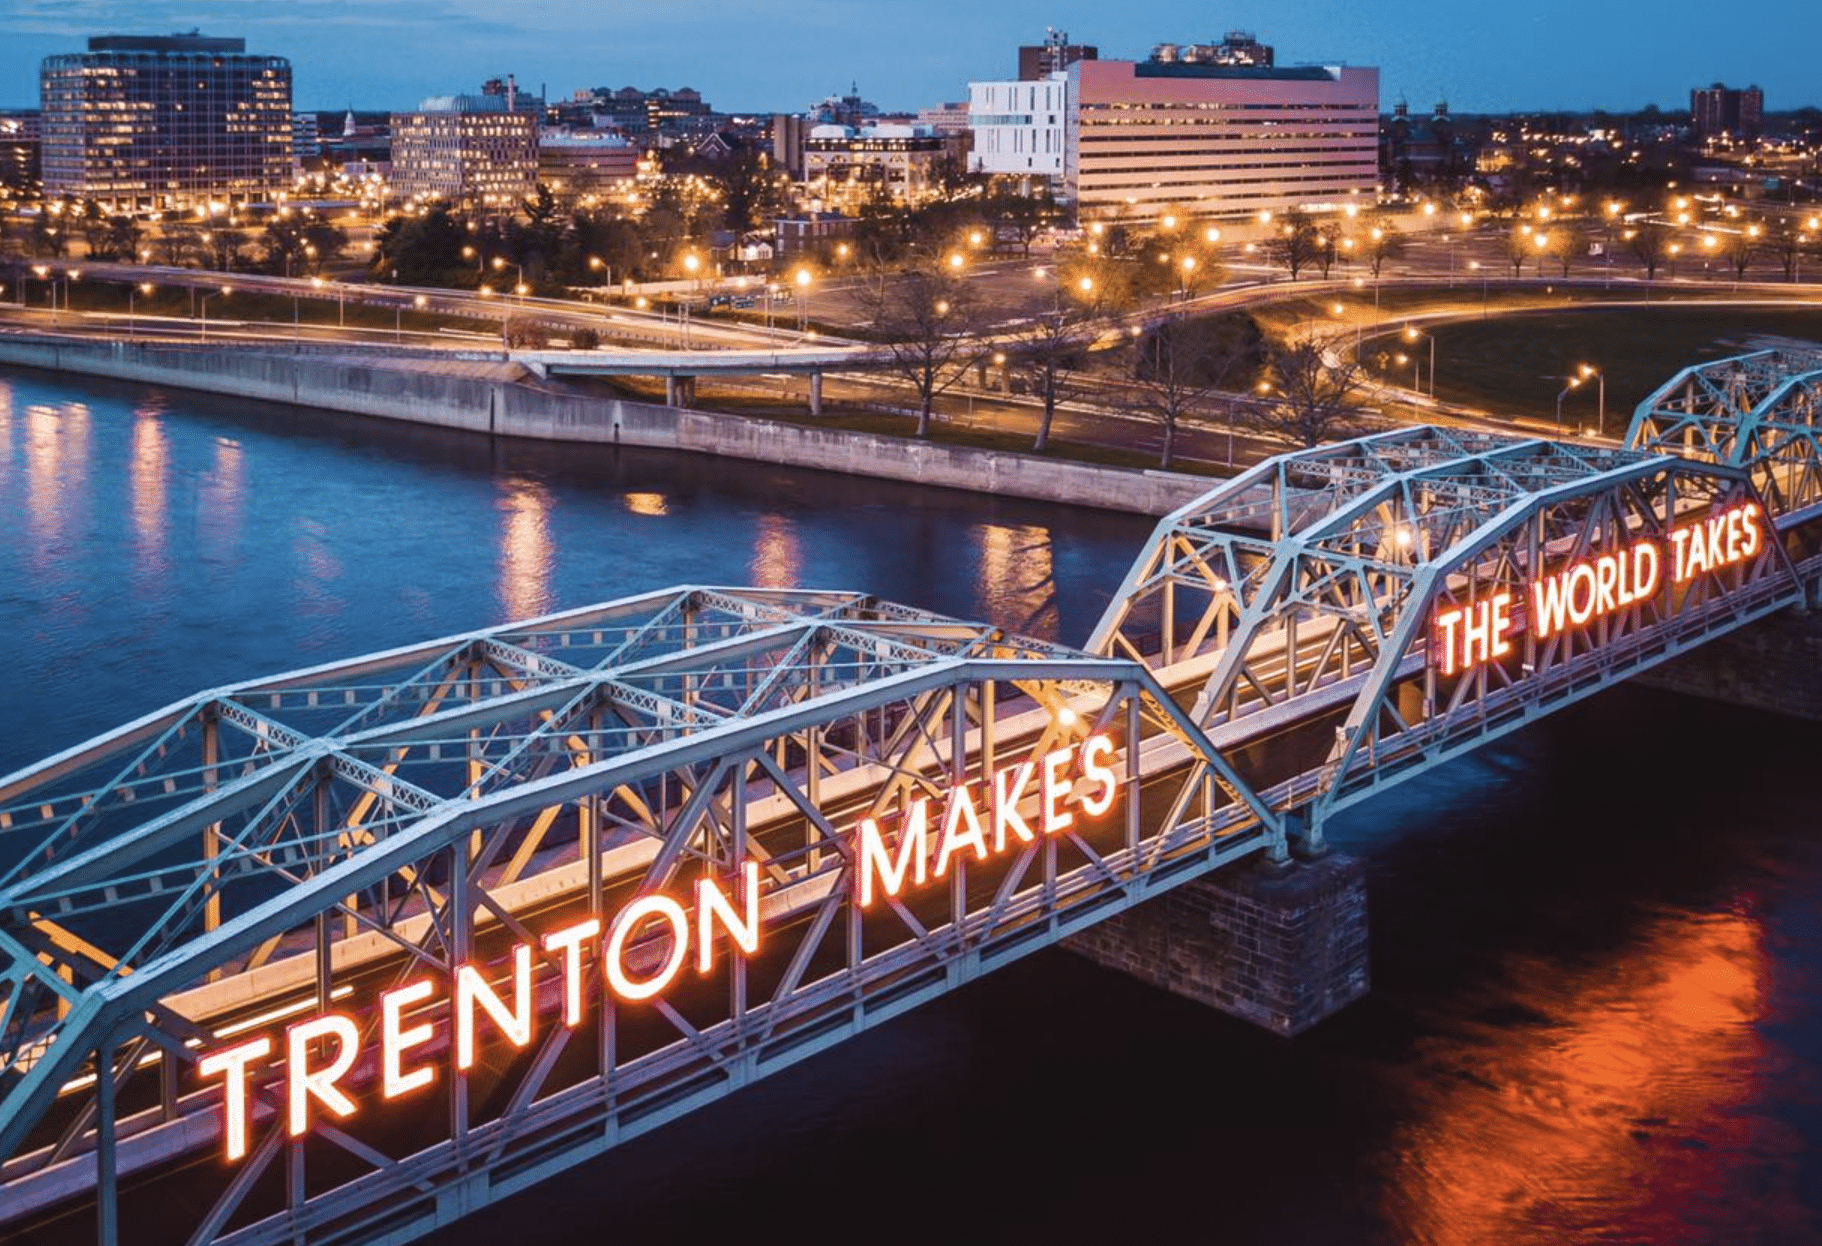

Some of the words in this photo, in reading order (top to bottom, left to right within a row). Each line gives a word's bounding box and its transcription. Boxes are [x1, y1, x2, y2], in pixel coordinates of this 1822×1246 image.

[1438, 593, 1511, 675] THE
[1534, 542, 1658, 638] WORLD
[1670, 503, 1758, 583] TAKES
[198, 860, 760, 1161] TRENTON
[858, 734, 1116, 907] MAKES
